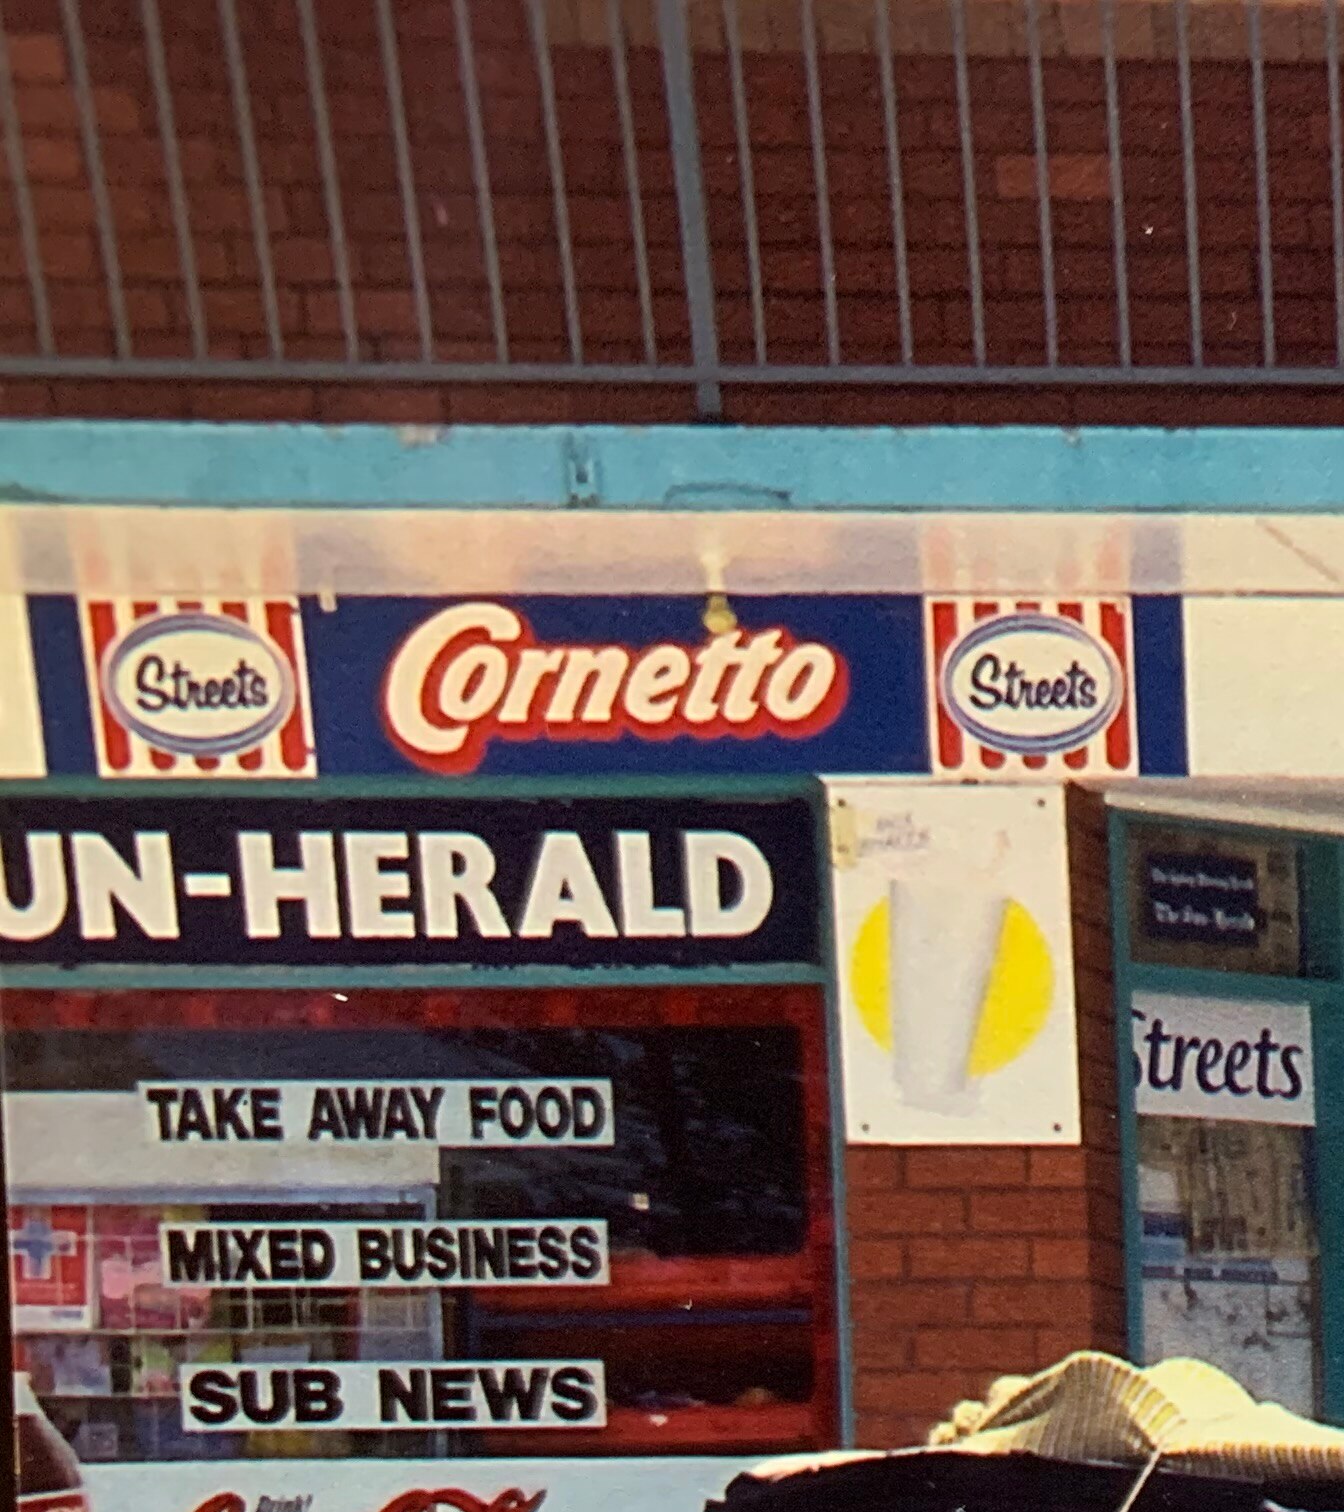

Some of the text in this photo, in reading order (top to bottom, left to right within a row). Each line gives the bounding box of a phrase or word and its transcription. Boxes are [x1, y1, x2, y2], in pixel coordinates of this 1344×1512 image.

[135, 655, 269, 712] Streets
[386, 602, 838, 753] Cornetto
[968, 654, 1099, 711] Streets
[0, 830, 774, 940] UN-HERALD
[148, 1088, 607, 1142] TAKE AWAY FOOD
[168, 1227, 601, 1282] MIXED BUSINESS
[189, 1367, 598, 1423] SUB NEWS
